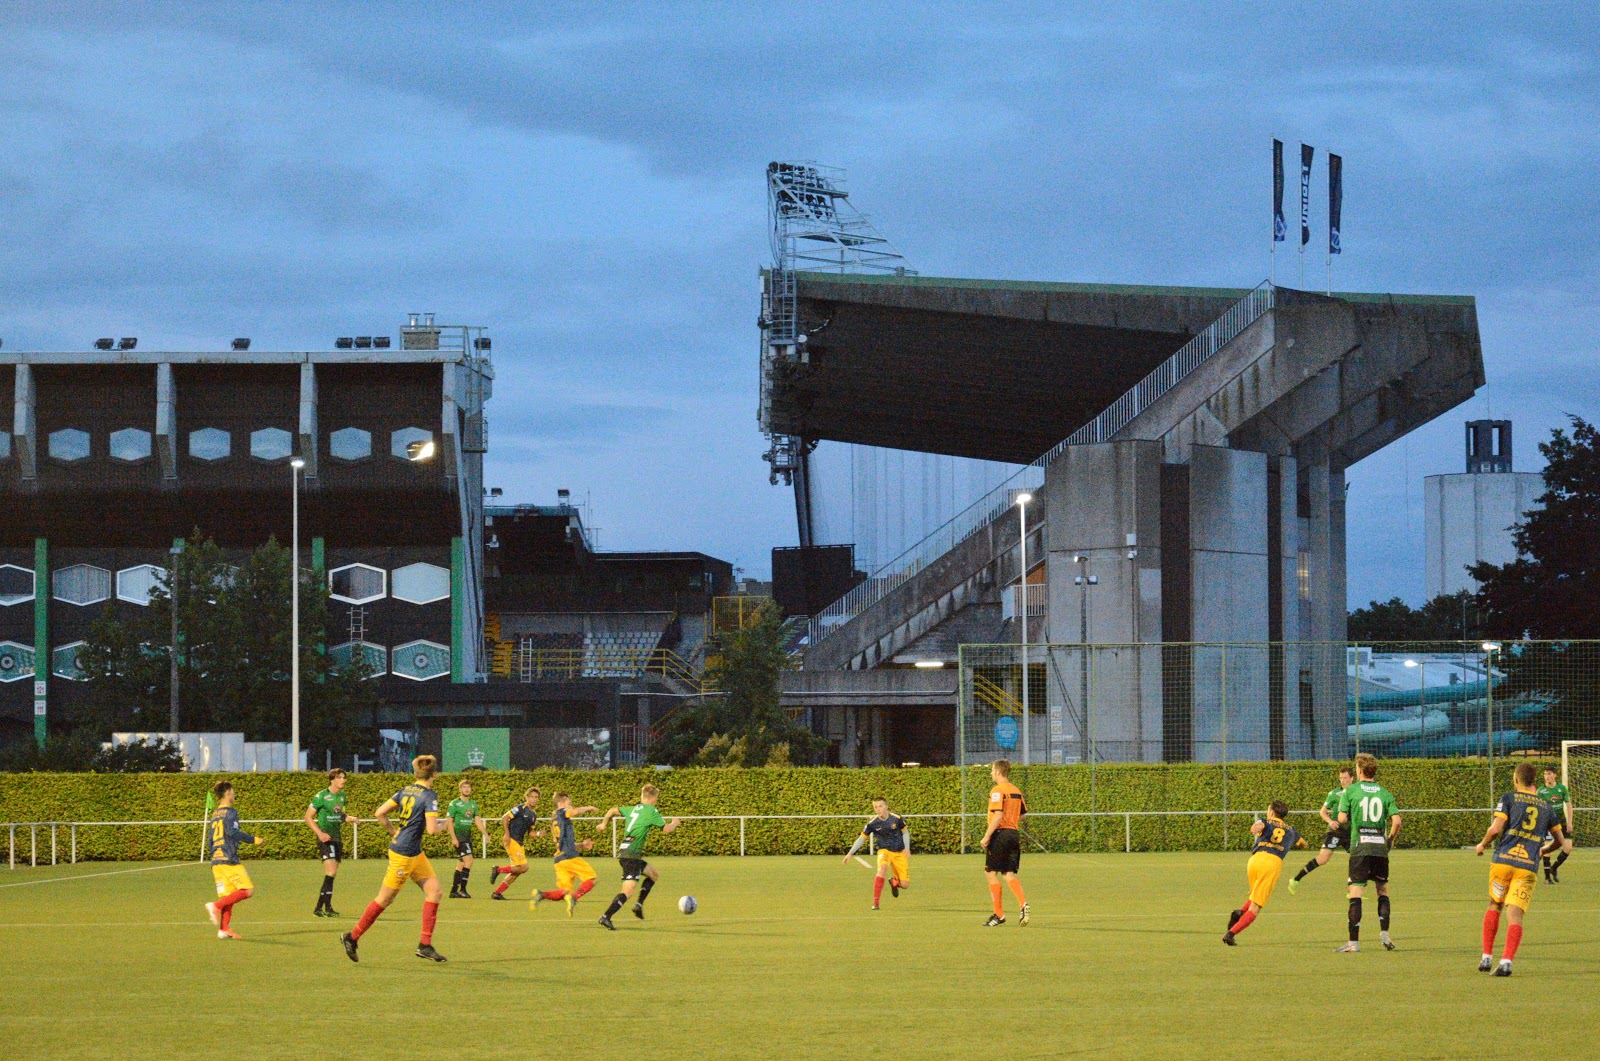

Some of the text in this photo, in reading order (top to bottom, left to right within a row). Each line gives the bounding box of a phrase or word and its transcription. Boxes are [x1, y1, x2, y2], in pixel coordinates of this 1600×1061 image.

[1359, 796, 1383, 823] 10
[1521, 806, 1539, 831] 3
[211, 819, 224, 842] 21
[627, 812, 639, 833] 7
[1270, 827, 1286, 844] 8
